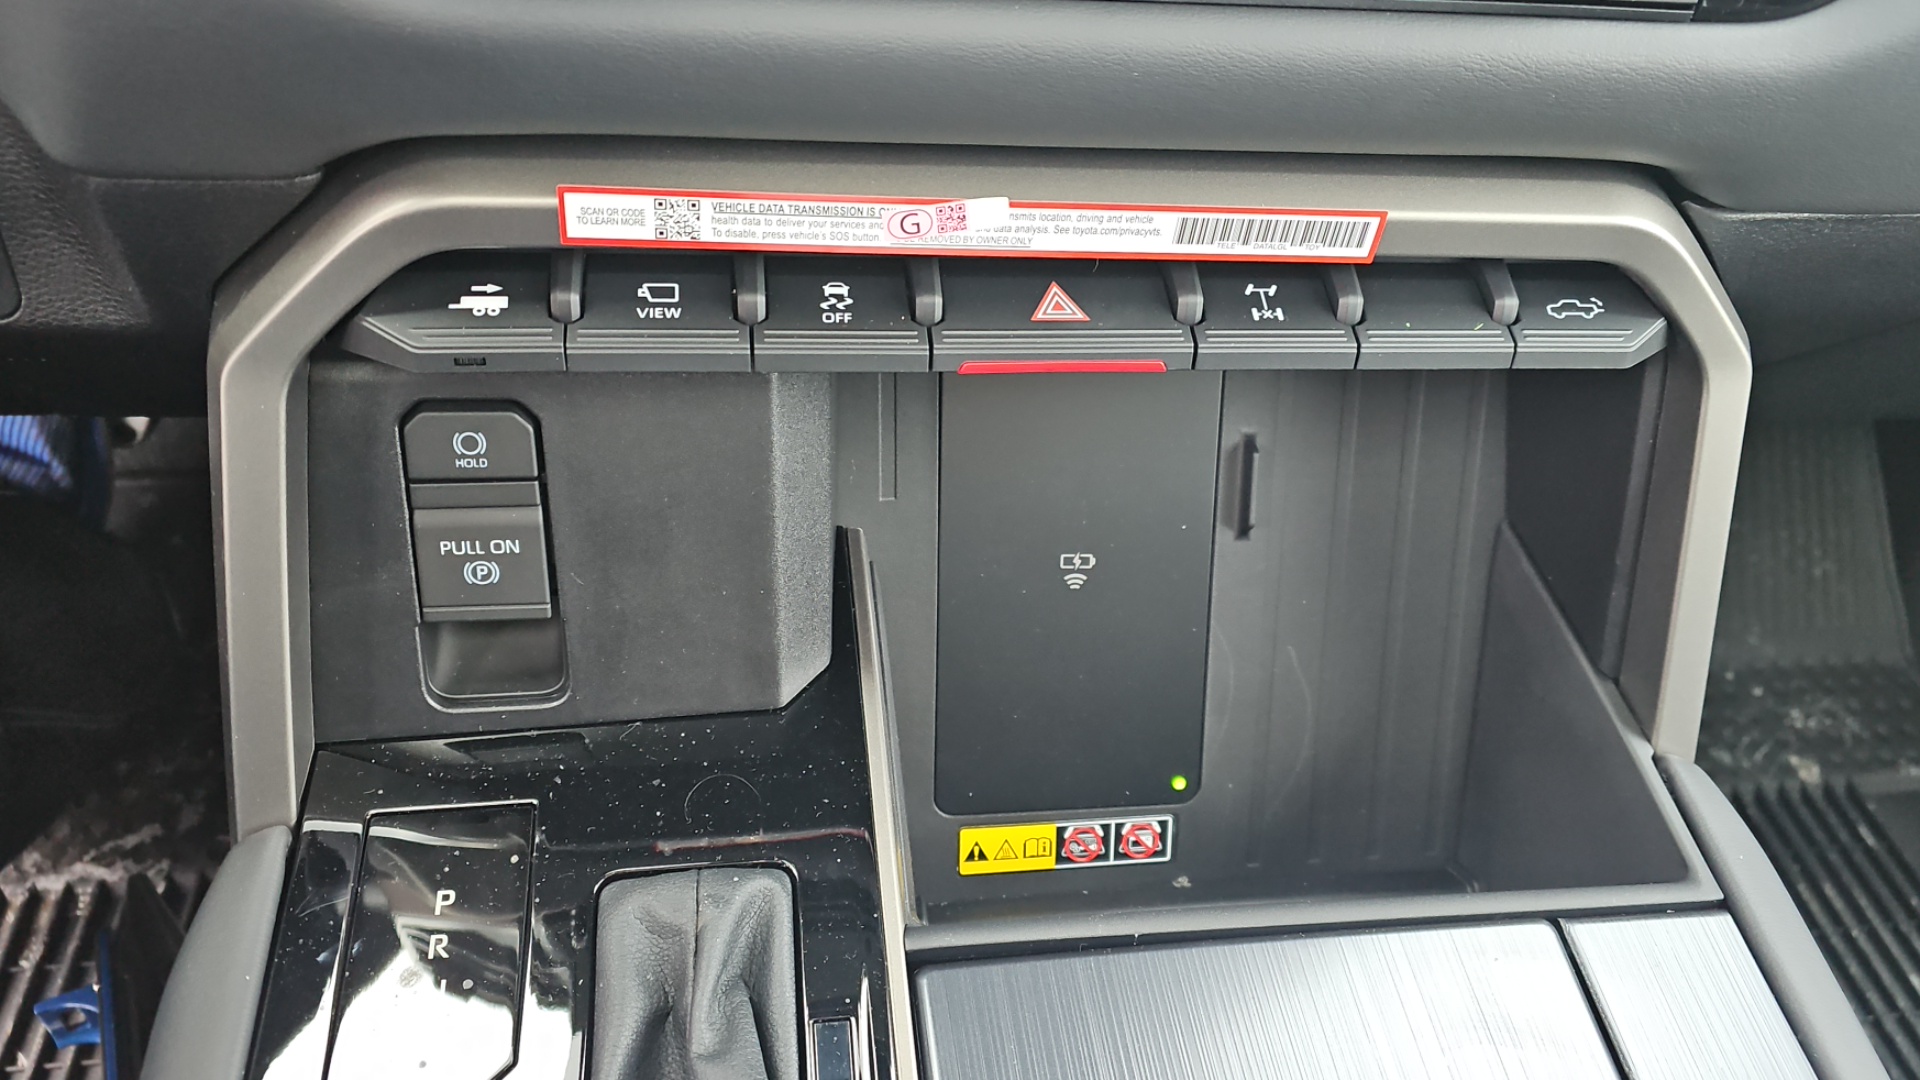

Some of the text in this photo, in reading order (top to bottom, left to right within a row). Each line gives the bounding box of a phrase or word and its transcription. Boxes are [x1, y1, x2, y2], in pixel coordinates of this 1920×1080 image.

[580, 206, 604, 216] SCAN
[621, 208, 646, 218] CODE
[711, 201, 755, 213] VEHICLE
[759, 204, 785, 214] DATA
[788, 205, 863, 217] TRANSMISSION
[867, 208, 876, 217] IS
[1039, 212, 1073, 223] location,
[1076, 213, 1104, 226] driving
[1107, 213, 1123, 223] and
[1125, 214, 1154, 224] vehicle
[577, 216, 646, 226] TO LEARN MORE
[711, 215, 739, 226] health
[742, 217, 761, 226] data
[765, 218, 773, 227] to
[776, 218, 805, 228] deliver
[808, 219, 827, 230] your
[830, 219, 866, 230] services
[1014, 225, 1050, 236] analysis.
[1053, 225, 1070, 235] See
[900, 212, 920, 235] G
[712, 227, 722, 238] To
[725, 228, 759, 239] disable,
[762, 231, 786, 242] press
[789, 230, 826, 241] vehicle's
[830, 231, 850, 242] SOS
[962, 234, 975, 244] BY
[976, 235, 1009, 244] OWNER
[1010, 236, 1034, 245] ONLY
[1217, 242, 1236, 250] TELE
[1305, 243, 1321, 251] TOY
[636, 307, 682, 319] VIEW
[822, 312, 853, 324] OFF
[455, 458, 488, 468] HOLD
[440, 539, 520, 556] PULL ON
[476, 565, 489, 581] P
[434, 889, 456, 916] P
[427, 934, 450, 960] R
